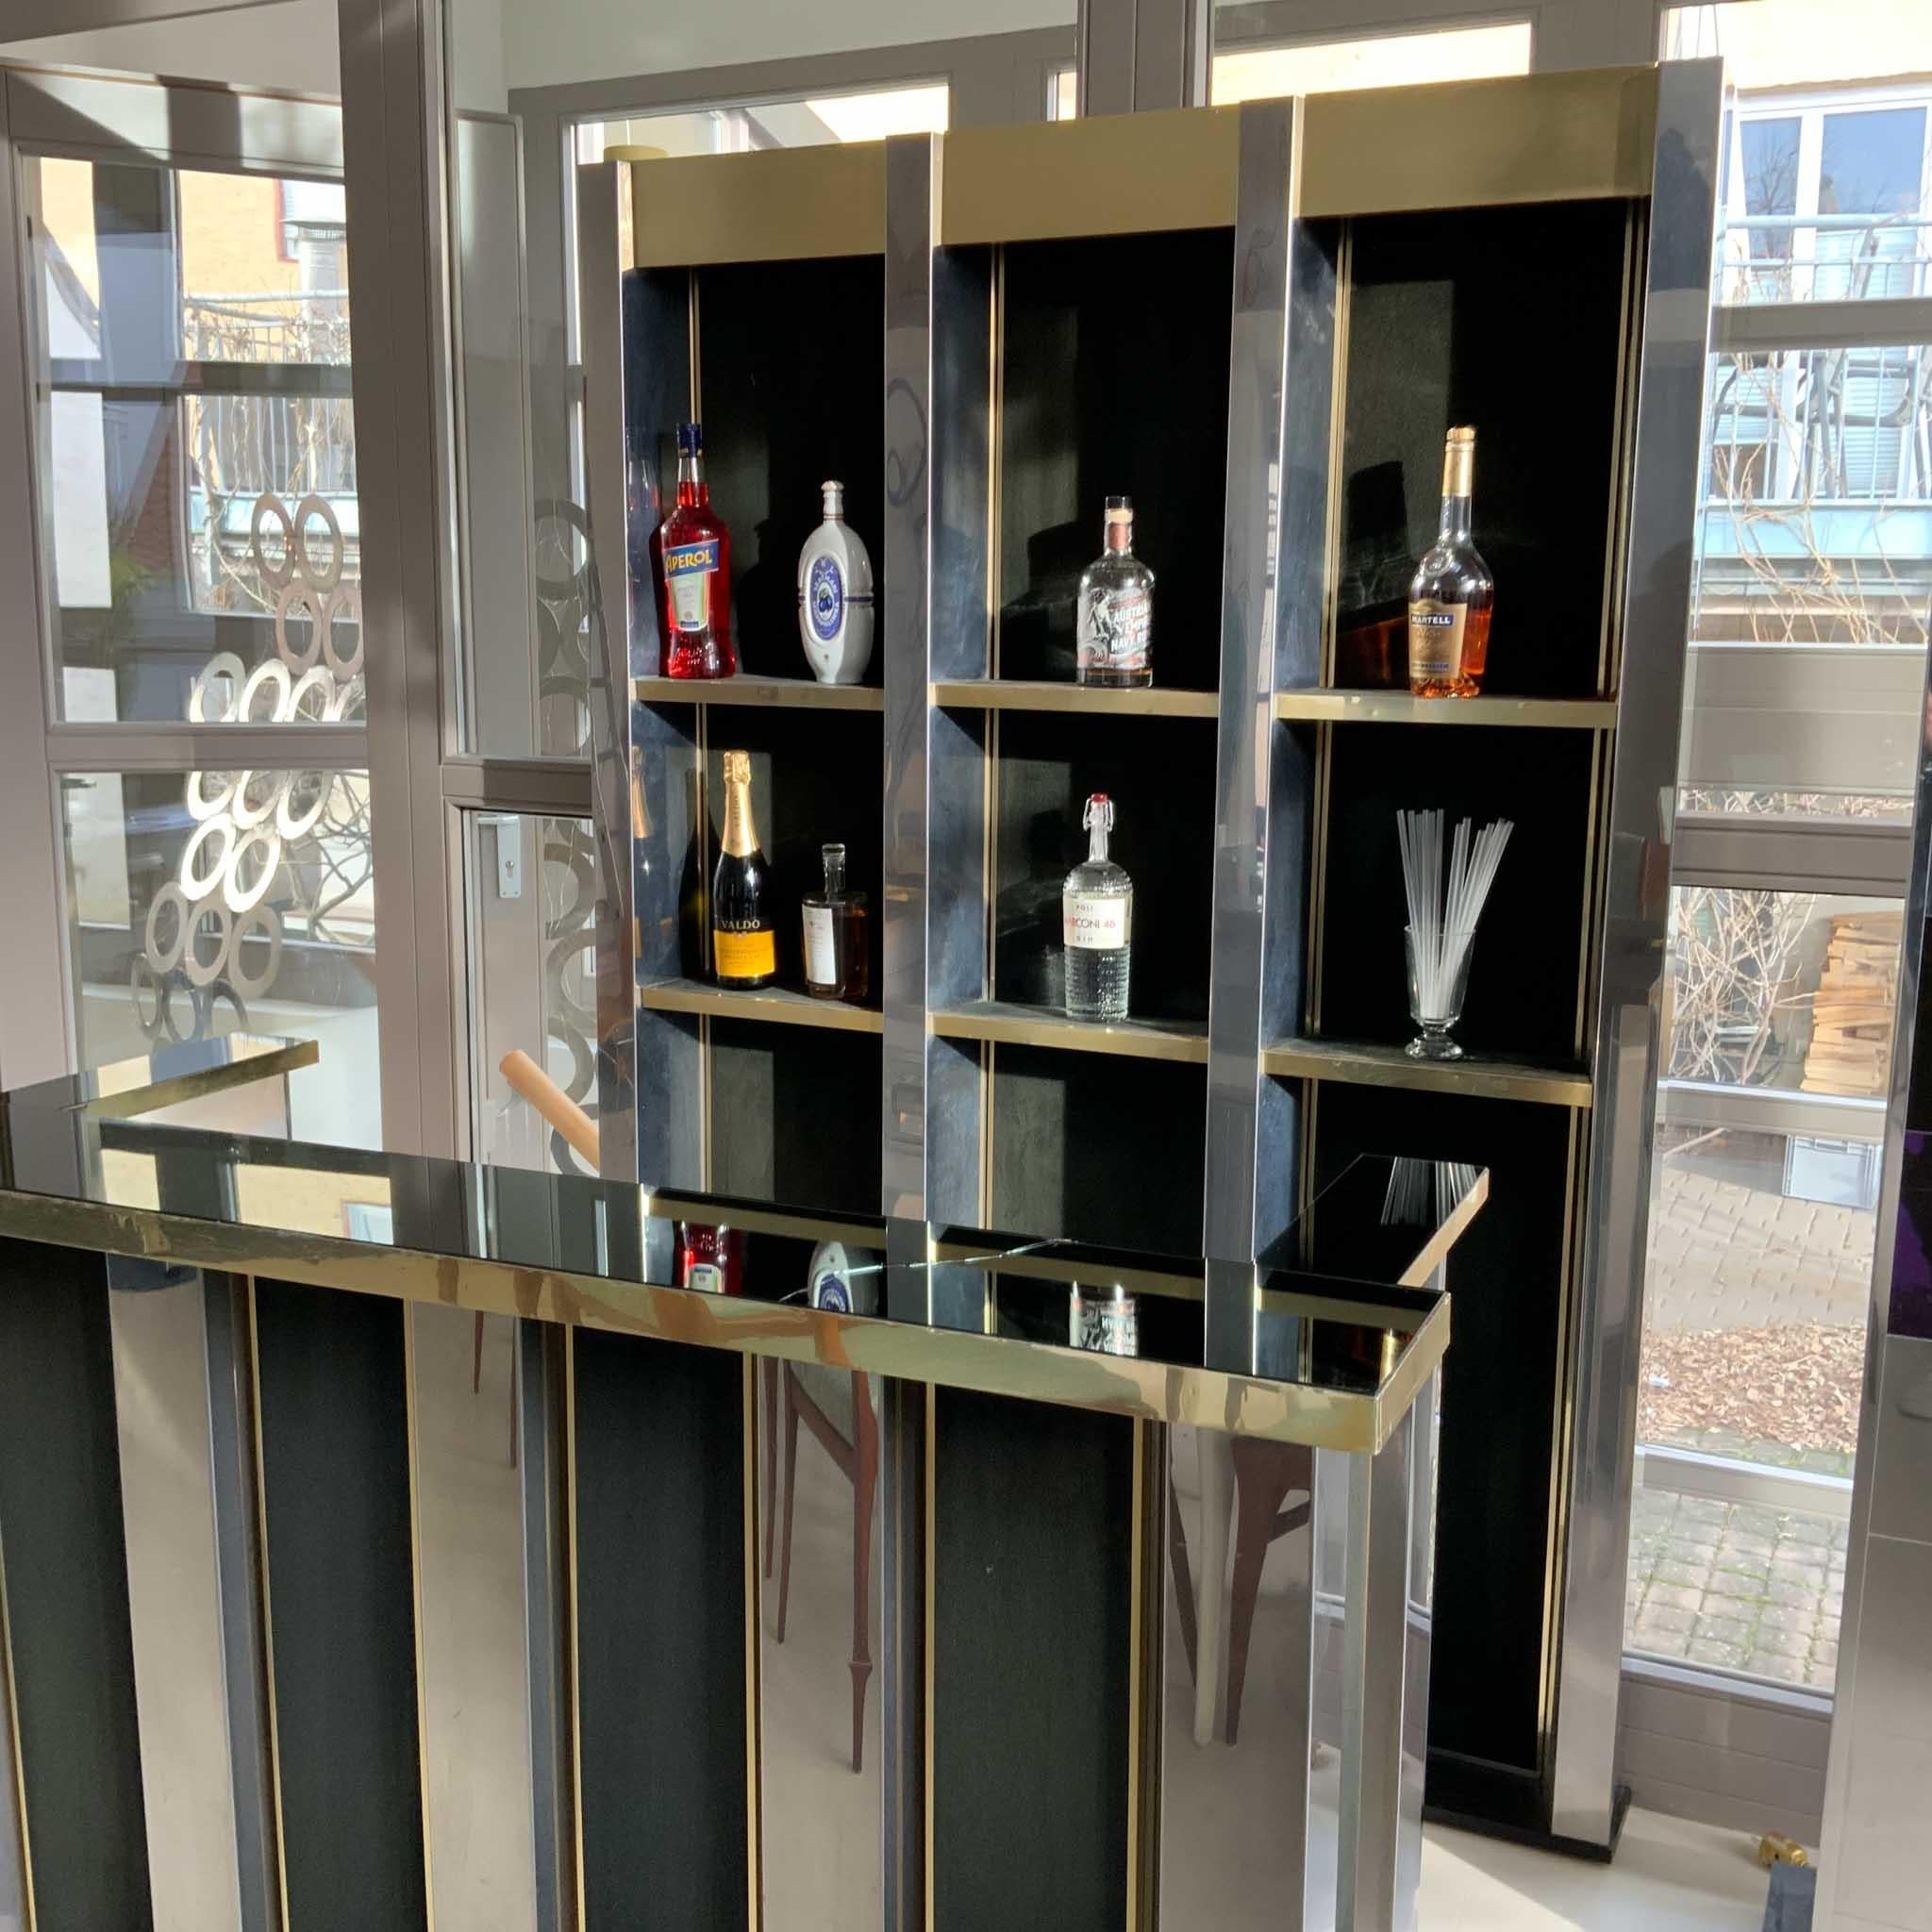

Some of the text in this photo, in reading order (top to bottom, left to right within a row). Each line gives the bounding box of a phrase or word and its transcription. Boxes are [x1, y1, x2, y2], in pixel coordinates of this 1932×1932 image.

[665, 549, 712, 571] APEROL
[1411, 616, 1451, 625] MARTELL
[721, 920, 760, 930] VALDO
